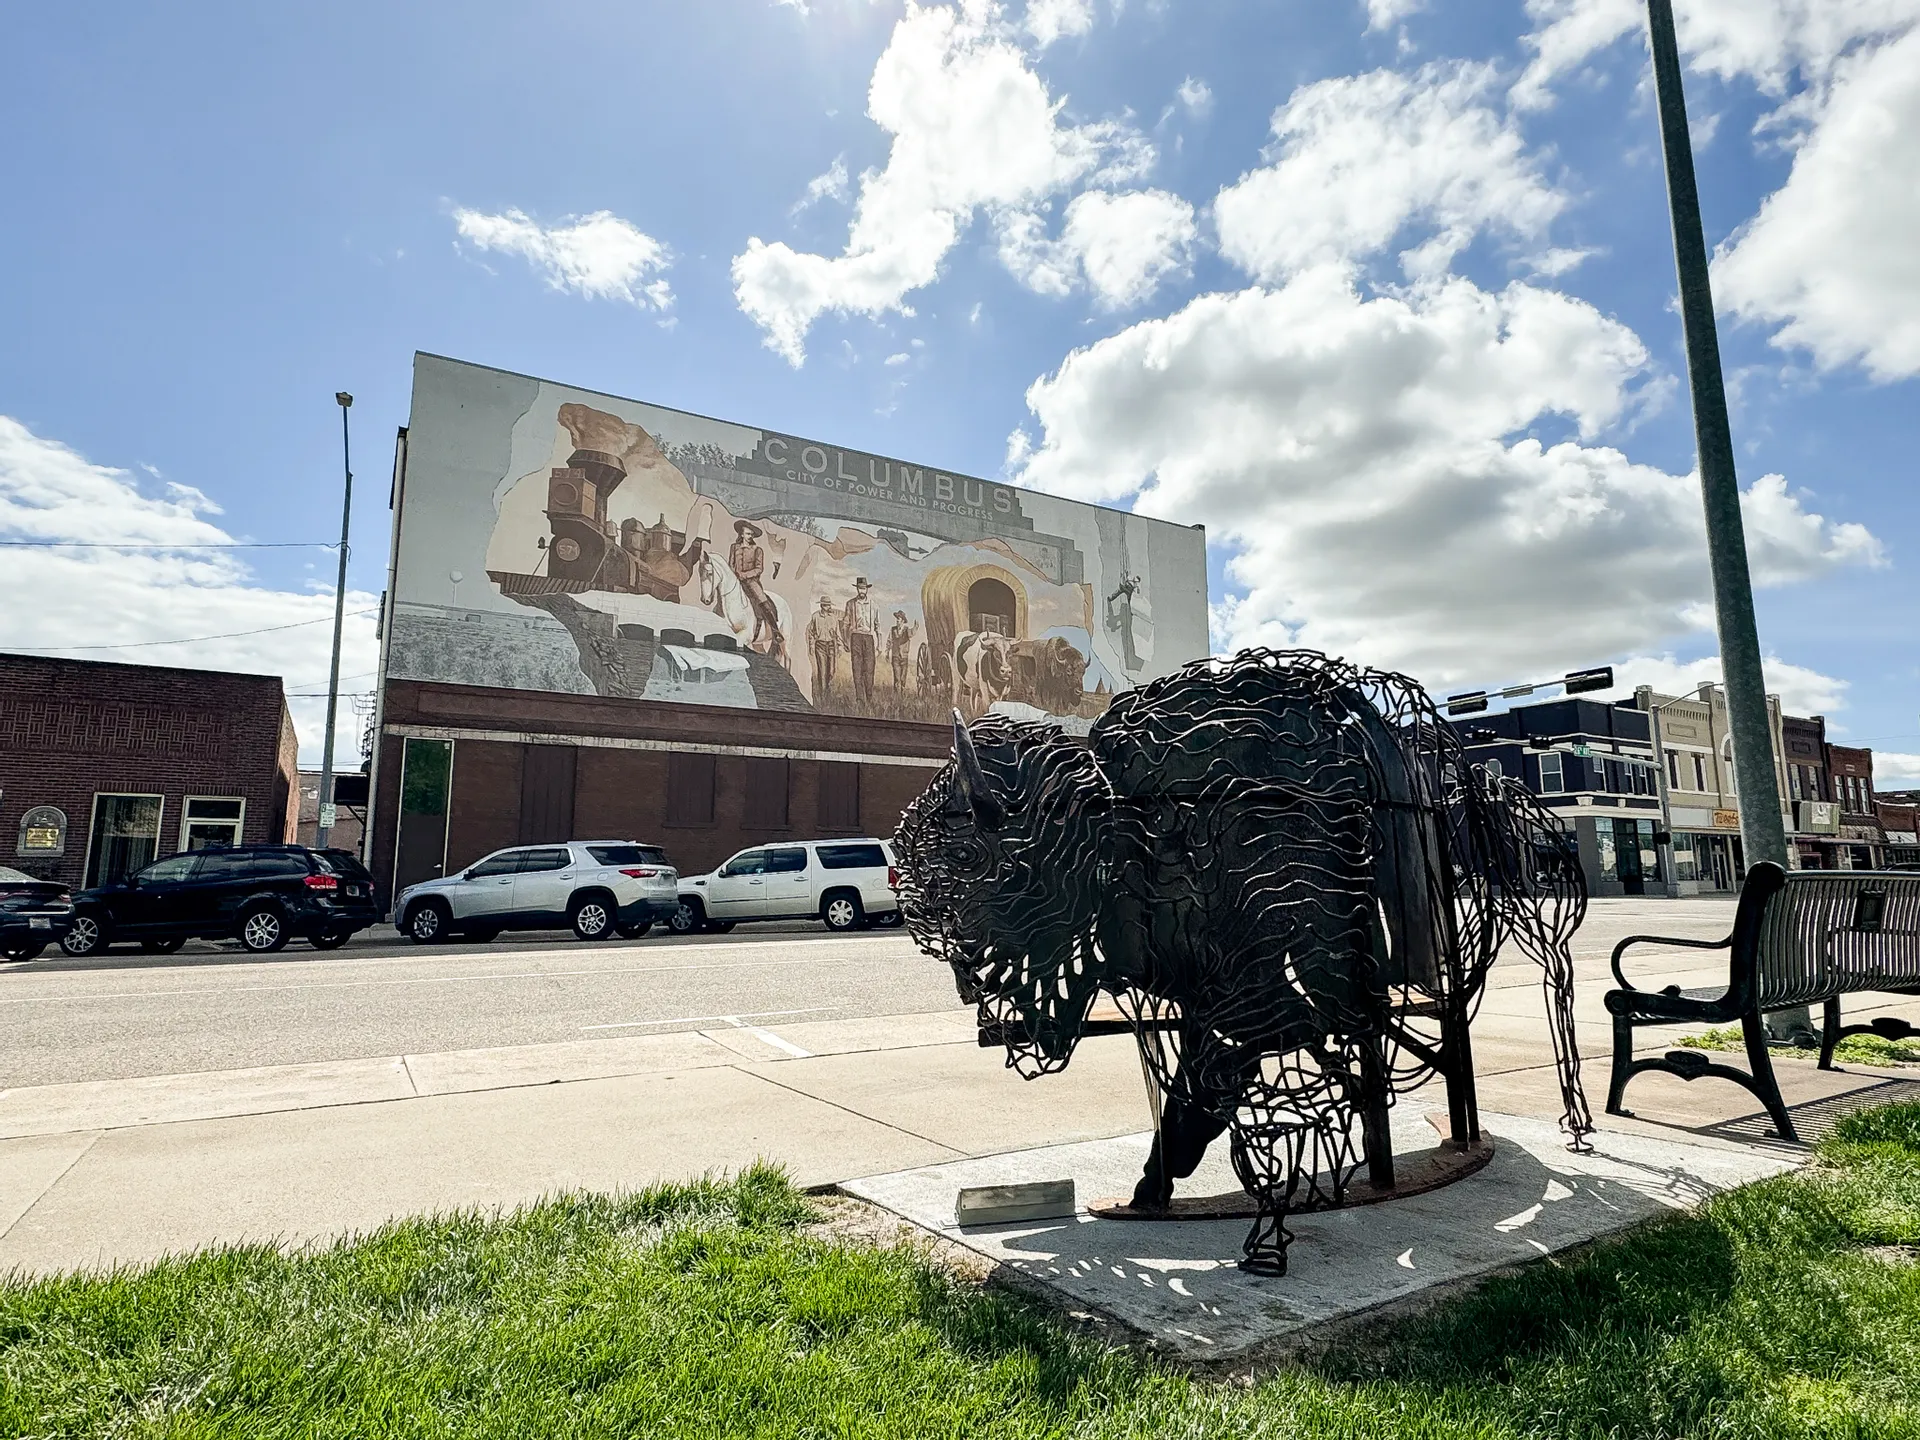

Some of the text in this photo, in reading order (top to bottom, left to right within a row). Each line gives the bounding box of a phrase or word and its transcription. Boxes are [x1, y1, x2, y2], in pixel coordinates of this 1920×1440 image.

[764, 438, 1011, 513] COLUMBUS
[786, 470, 994, 521] CITY OF POWER AND PROGRESS
